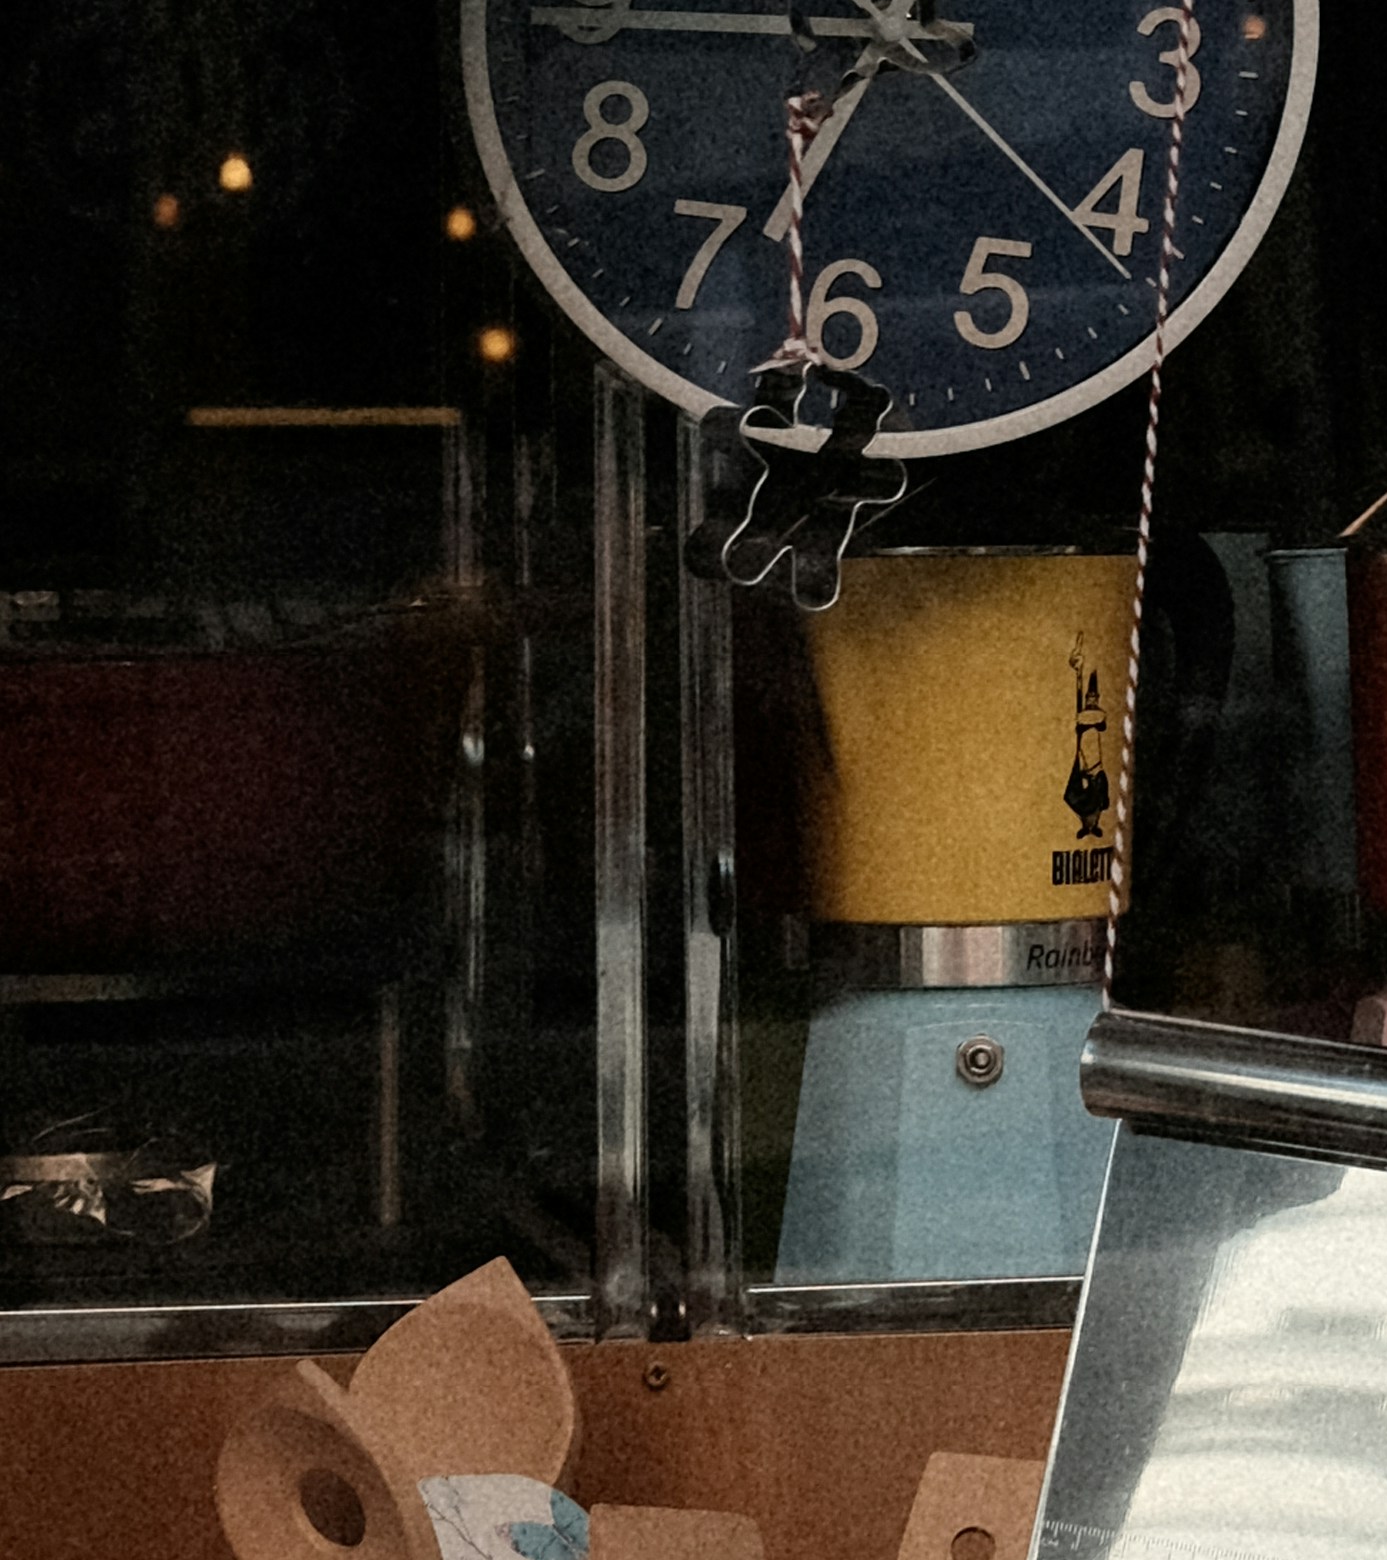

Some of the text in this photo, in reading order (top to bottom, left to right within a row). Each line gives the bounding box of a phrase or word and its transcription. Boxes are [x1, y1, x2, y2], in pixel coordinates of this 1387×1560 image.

[1128, 7, 1201, 119] 3
[571, 81, 648, 192] 8
[671, 199, 747, 310] 7
[1074, 148, 1148, 256] 4
[806, 258, 881, 371] 6
[953, 237, 1032, 350] 5
[1052, 846, 1113, 885] BIALETT
